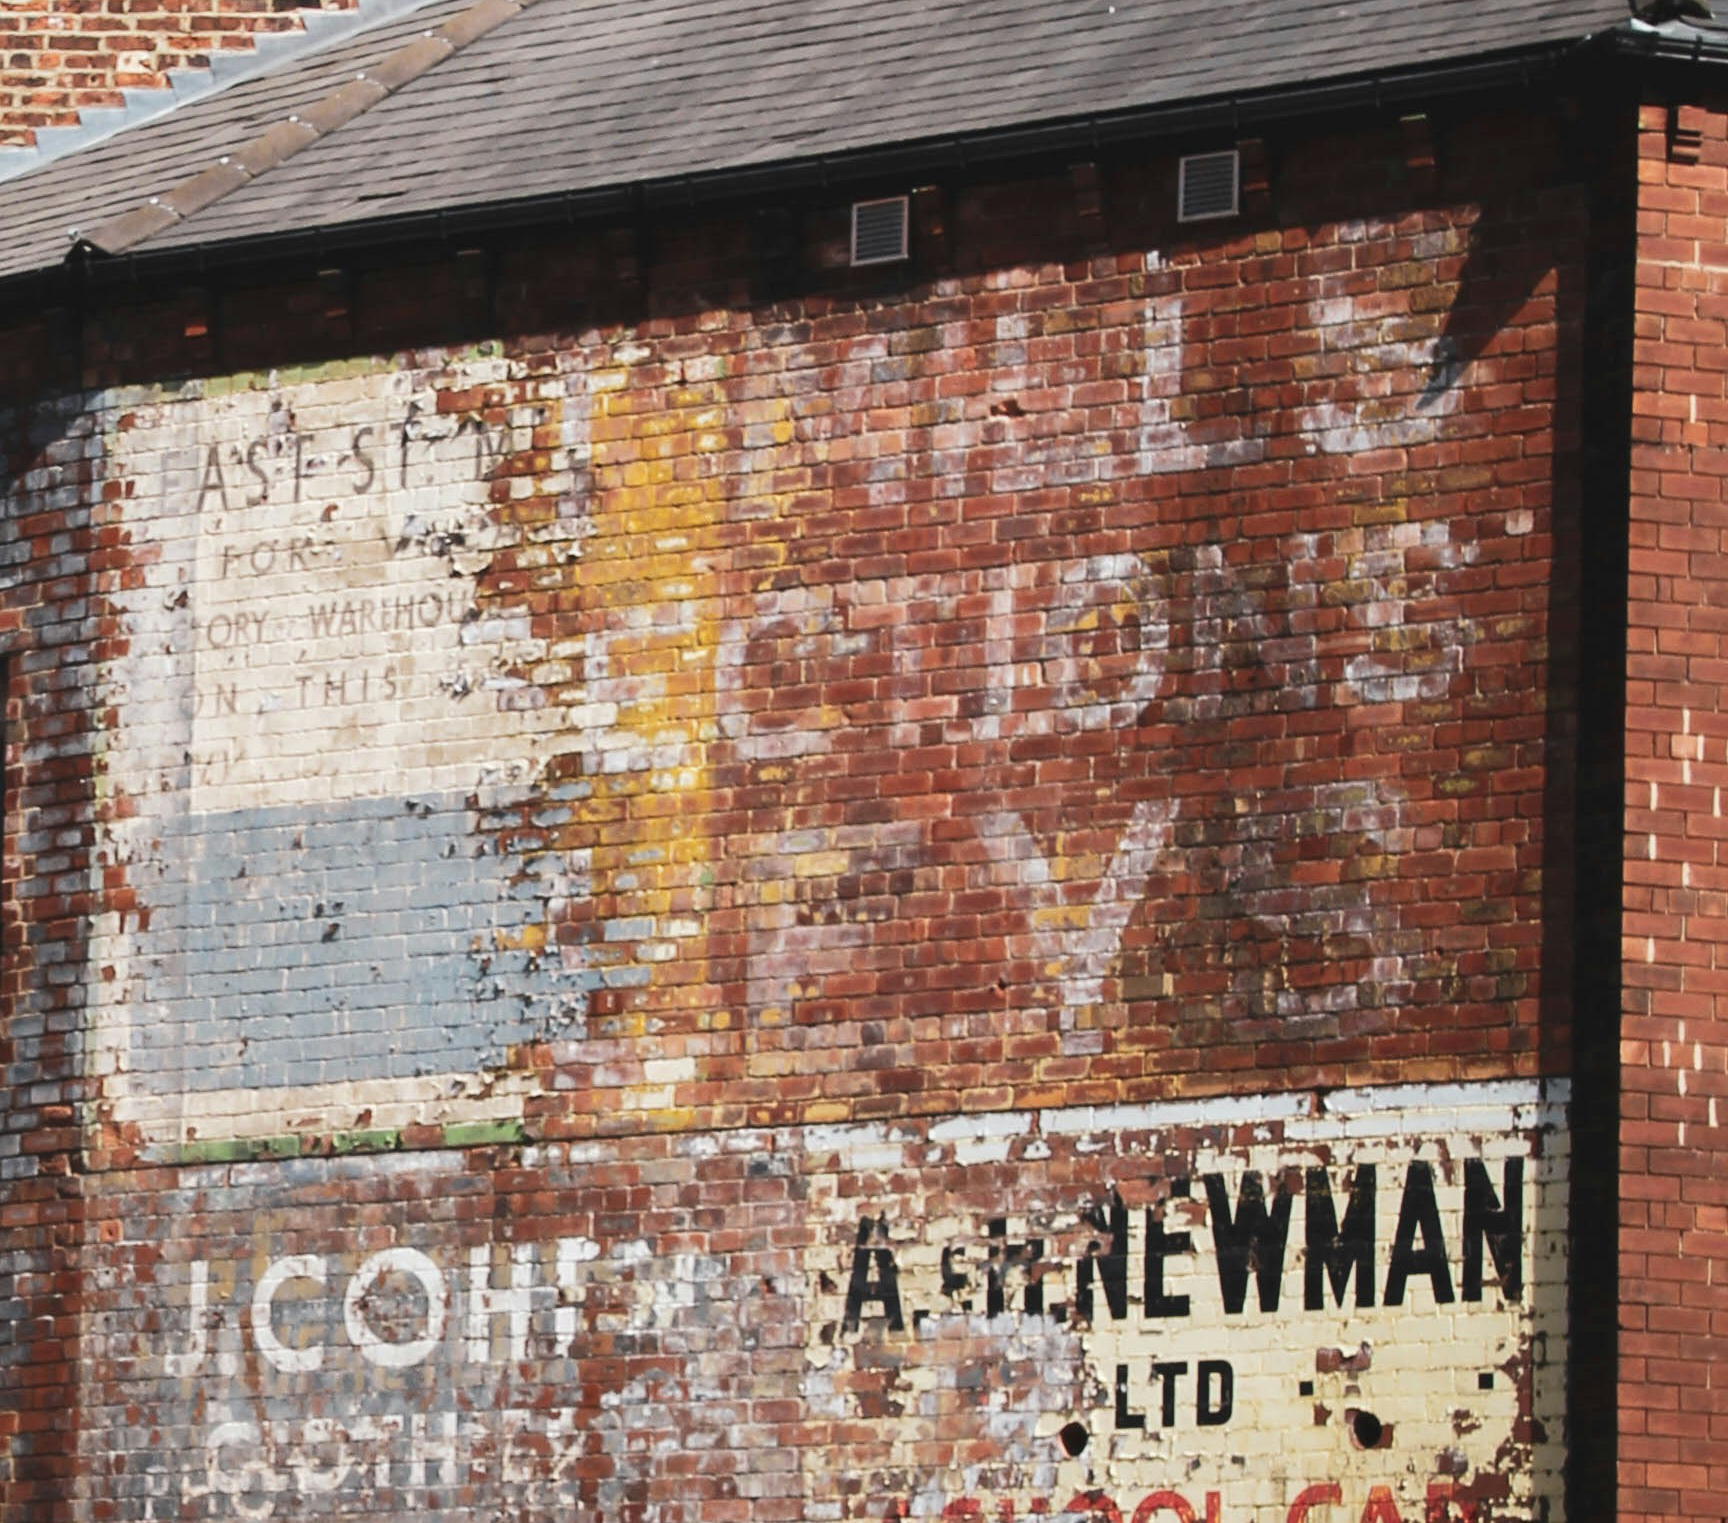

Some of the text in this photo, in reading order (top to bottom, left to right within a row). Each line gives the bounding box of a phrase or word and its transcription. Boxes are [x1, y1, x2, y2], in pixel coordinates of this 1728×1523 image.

[223, 538, 309, 577] FOR
[296, 664, 398, 708] THIS
[1075, 1156, 1524, 1322] NEWMAN
[1115, 1359, 1233, 1429] LTD
